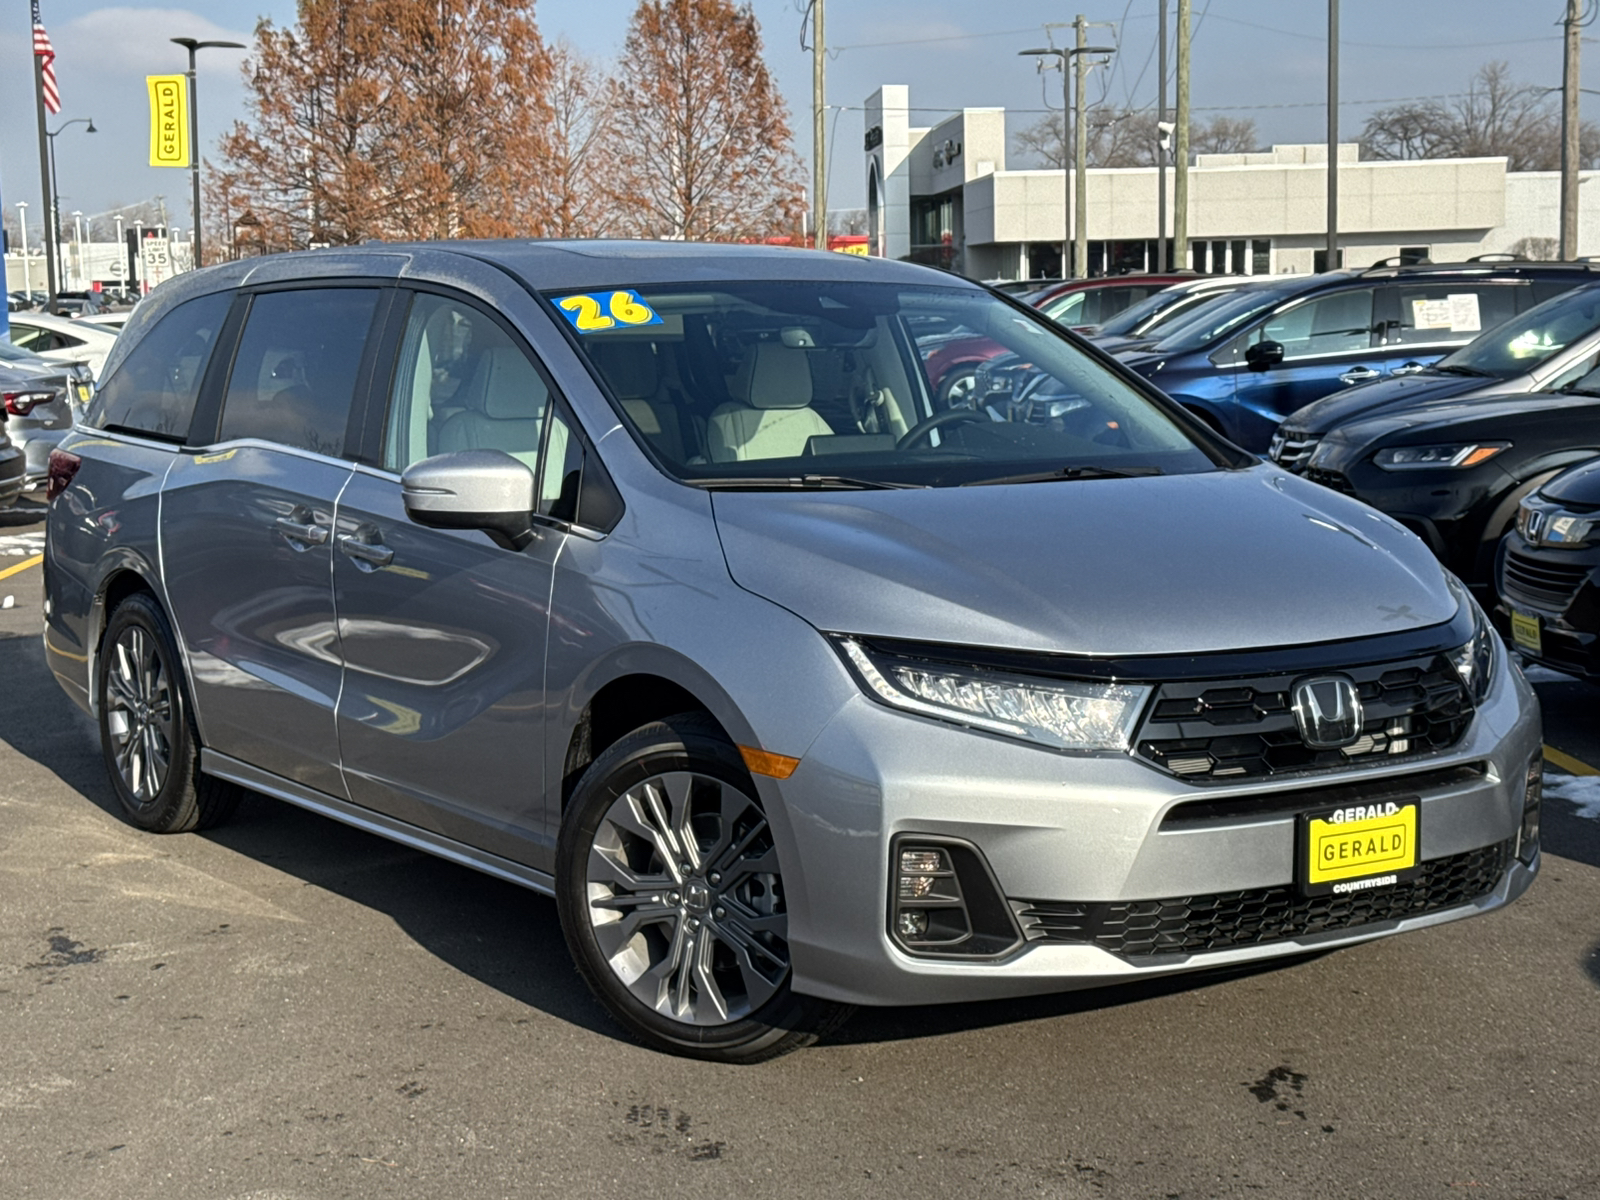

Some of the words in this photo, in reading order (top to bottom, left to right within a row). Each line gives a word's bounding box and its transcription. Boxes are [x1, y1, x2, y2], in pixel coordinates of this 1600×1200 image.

[162, 87, 176, 154] GERALD
[147, 253, 167, 264] 35
[560, 291, 653, 330] 26
[1324, 834, 1402, 861] GERALD
[1333, 875, 1397, 893] COUNTRYSIDE
